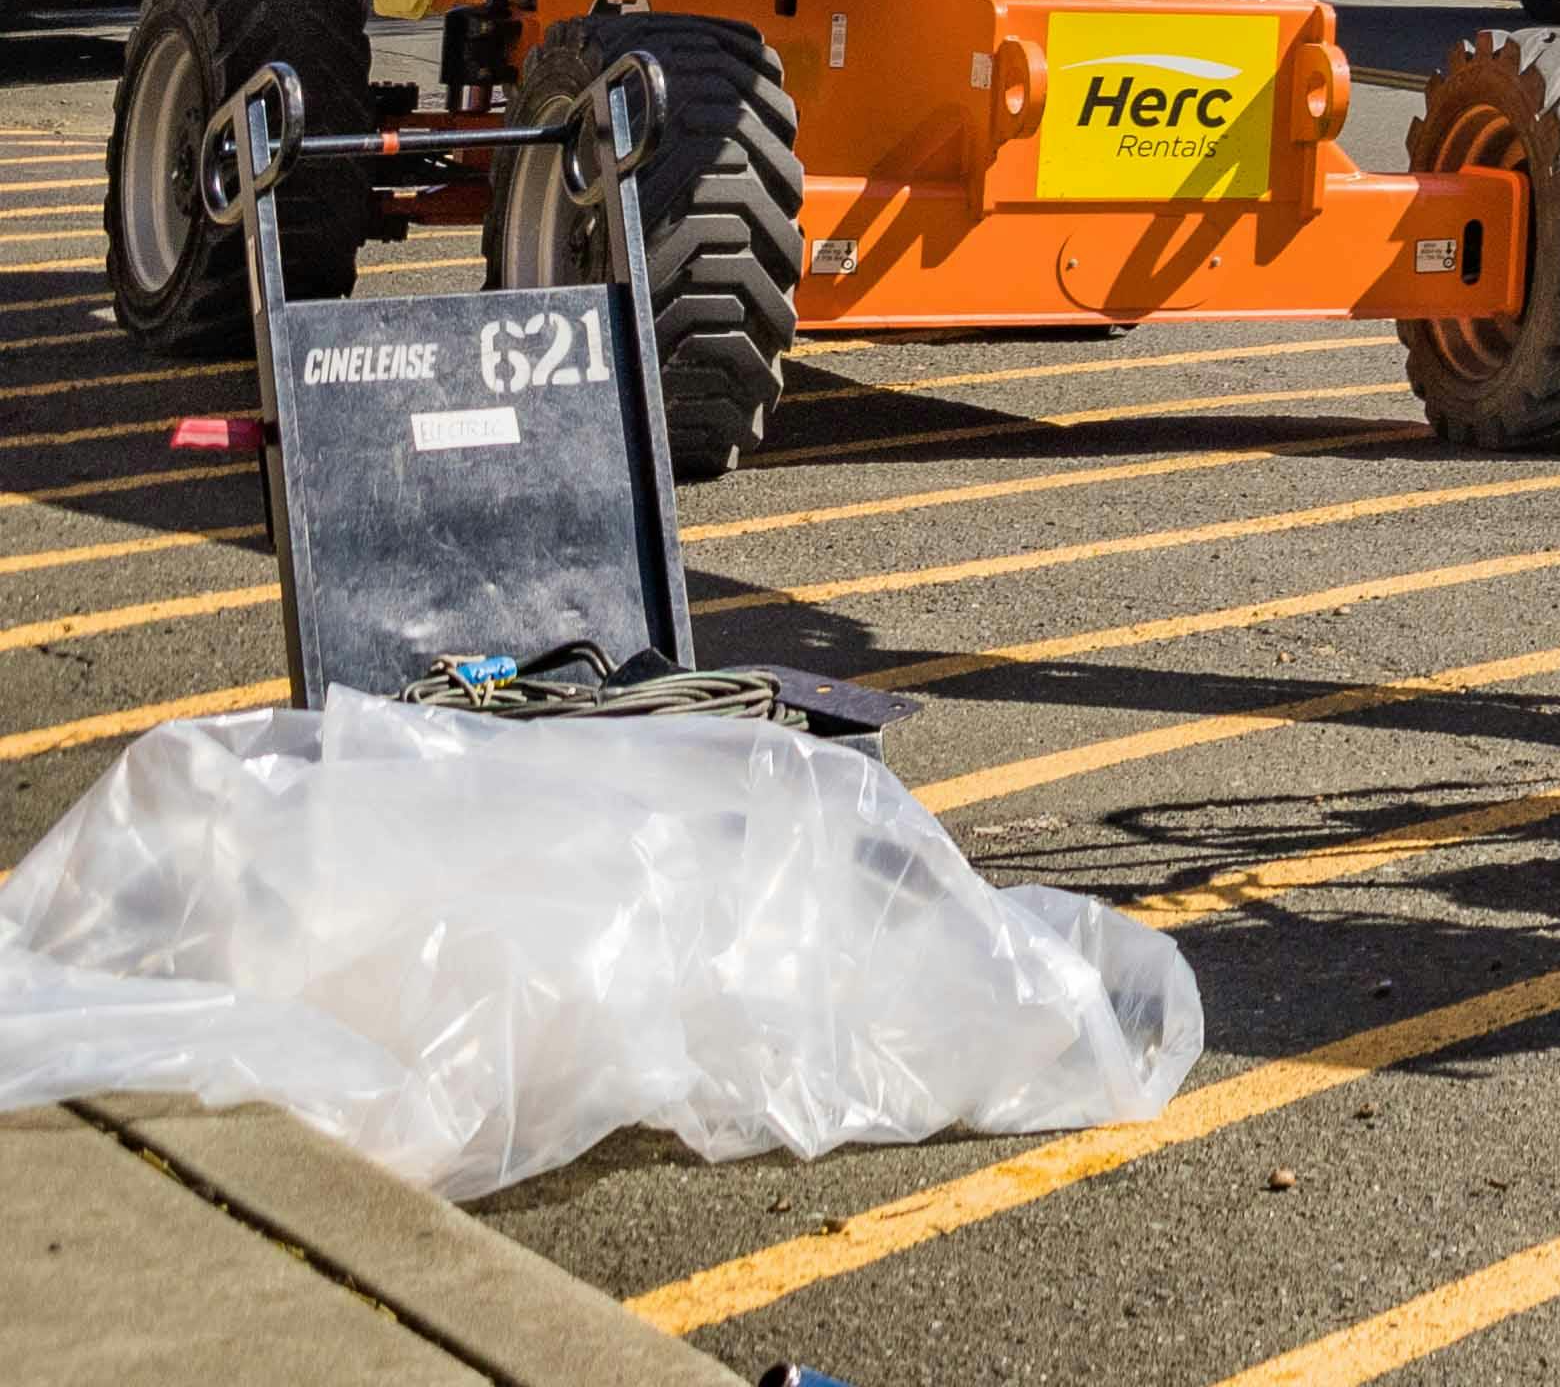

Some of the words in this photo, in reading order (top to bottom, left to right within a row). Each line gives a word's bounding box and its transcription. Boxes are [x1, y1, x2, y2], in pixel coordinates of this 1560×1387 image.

[1077, 76, 1233, 127] Herc
[1116, 134, 1219, 158] Rentals
[304, 342, 438, 385] CINELEASE
[480, 307, 610, 393] 621
